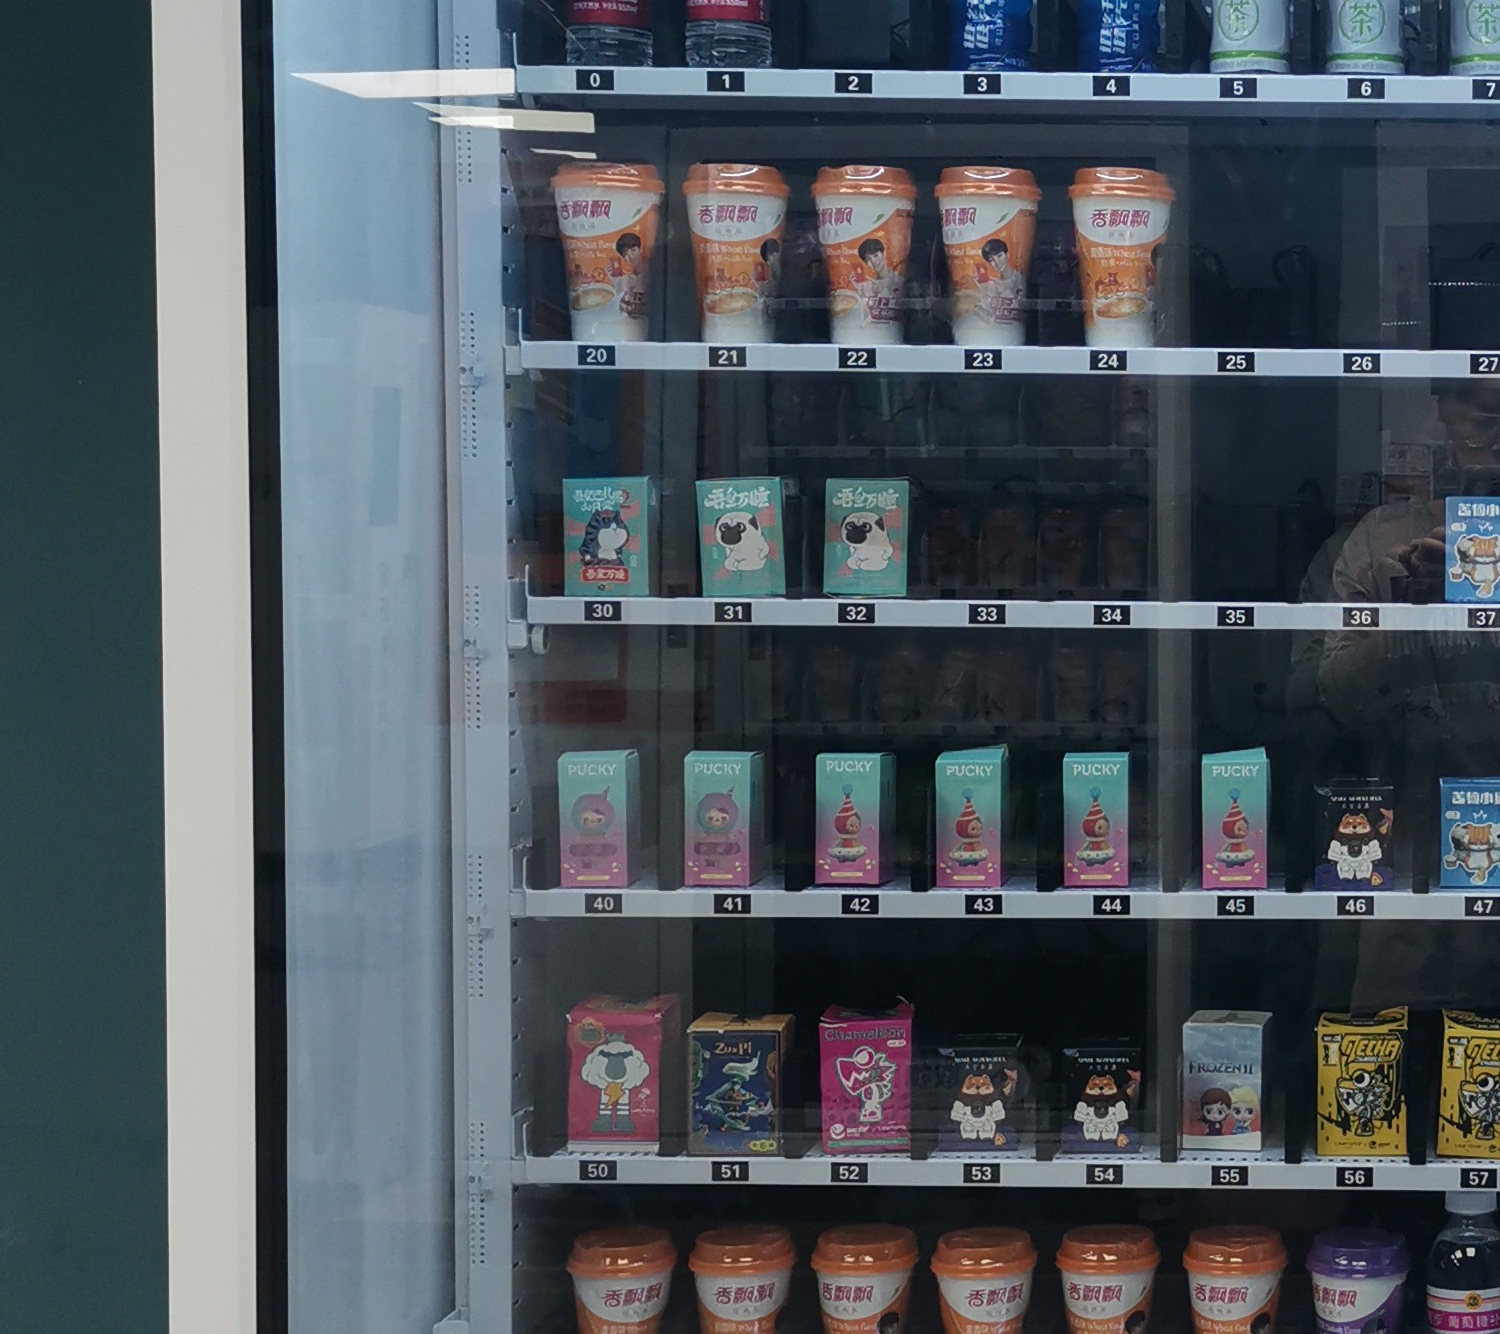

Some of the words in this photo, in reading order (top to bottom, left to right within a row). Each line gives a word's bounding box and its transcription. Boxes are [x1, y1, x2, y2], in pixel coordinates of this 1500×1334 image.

[1348, 1, 1378, 38] 茶
[589, 72, 601, 88] 0
[721, 74, 730, 89] 1
[847, 75, 859, 91] 2
[977, 76, 988, 92] 3
[1105, 78, 1117, 94] 4
[1233, 80, 1244, 96] 5
[1360, 81, 1372, 97] 6
[1486, 82, 1496, 98] 7
[558, 199, 612, 221] 香飘飘
[699, 204, 759, 225] 香飘飘
[817, 206, 853, 227] 飘飘
[940, 206, 978, 227] 飘飘
[1089, 208, 1151, 229] 香飘飘
[586, 347, 608, 363] 20
[717, 349, 738, 365] 21
[846, 351, 868, 366] 22
[972, 352, 994, 367] 23
[1097, 353, 1120, 369] 24
[1225, 354, 1247, 370] 25
[1351, 356, 1373, 371] 26
[1478, 356, 1499, 372] 27
[592, 603, 614, 618] 30
[723, 605, 743, 620] 31
[845, 605, 867, 621] 32
[977, 606, 998, 622] 33
[1101, 607, 1123, 623] 34
[1225, 609, 1246, 624] 35
[1350, 610, 1372, 625] 36
[1475, 610, 1496, 626] 37
[567, 763, 616, 776] PUCKY
[693, 762, 742, 776] PUCKY
[825, 760, 874, 773] PUCKY
[946, 764, 994, 777] PUCKY
[1072, 763, 1121, 776] PUCKY
[1211, 765, 1260, 778] PUCKY
[593, 896, 615, 911] 40
[722, 896, 742, 912] 41
[849, 897, 871, 912] 42
[973, 897, 994, 912] 43
[1101, 898, 1123, 913] 44
[1225, 898, 1246, 913] 45
[1345, 898, 1367, 913] 46
[1473, 899, 1494, 914] 47
[824, 1027, 906, 1042] Chameleon
[1189, 1060, 1242, 1074] FROZEN
[587, 1163, 609, 1178] 50
[721, 1164, 740, 1179] 51
[839, 1165, 860, 1180] 52
[971, 1166, 992, 1181] 53
[1094, 1167, 1115, 1182] 54
[1219, 1168, 1240, 1183] 55
[1344, 1169, 1365, 1185] 56
[1469, 1171, 1489, 1186] 57
[601, 1280, 665, 1309] 香飘飘
[713, 1281, 776, 1306] 香飘飘
[821, 1281, 875, 1304] 香飘飘
[964, 1281, 1025, 1308] 香飘飘
[1066, 1281, 1125, 1304] 香飘飘
[1193, 1282, 1249, 1305] 香飘飘
